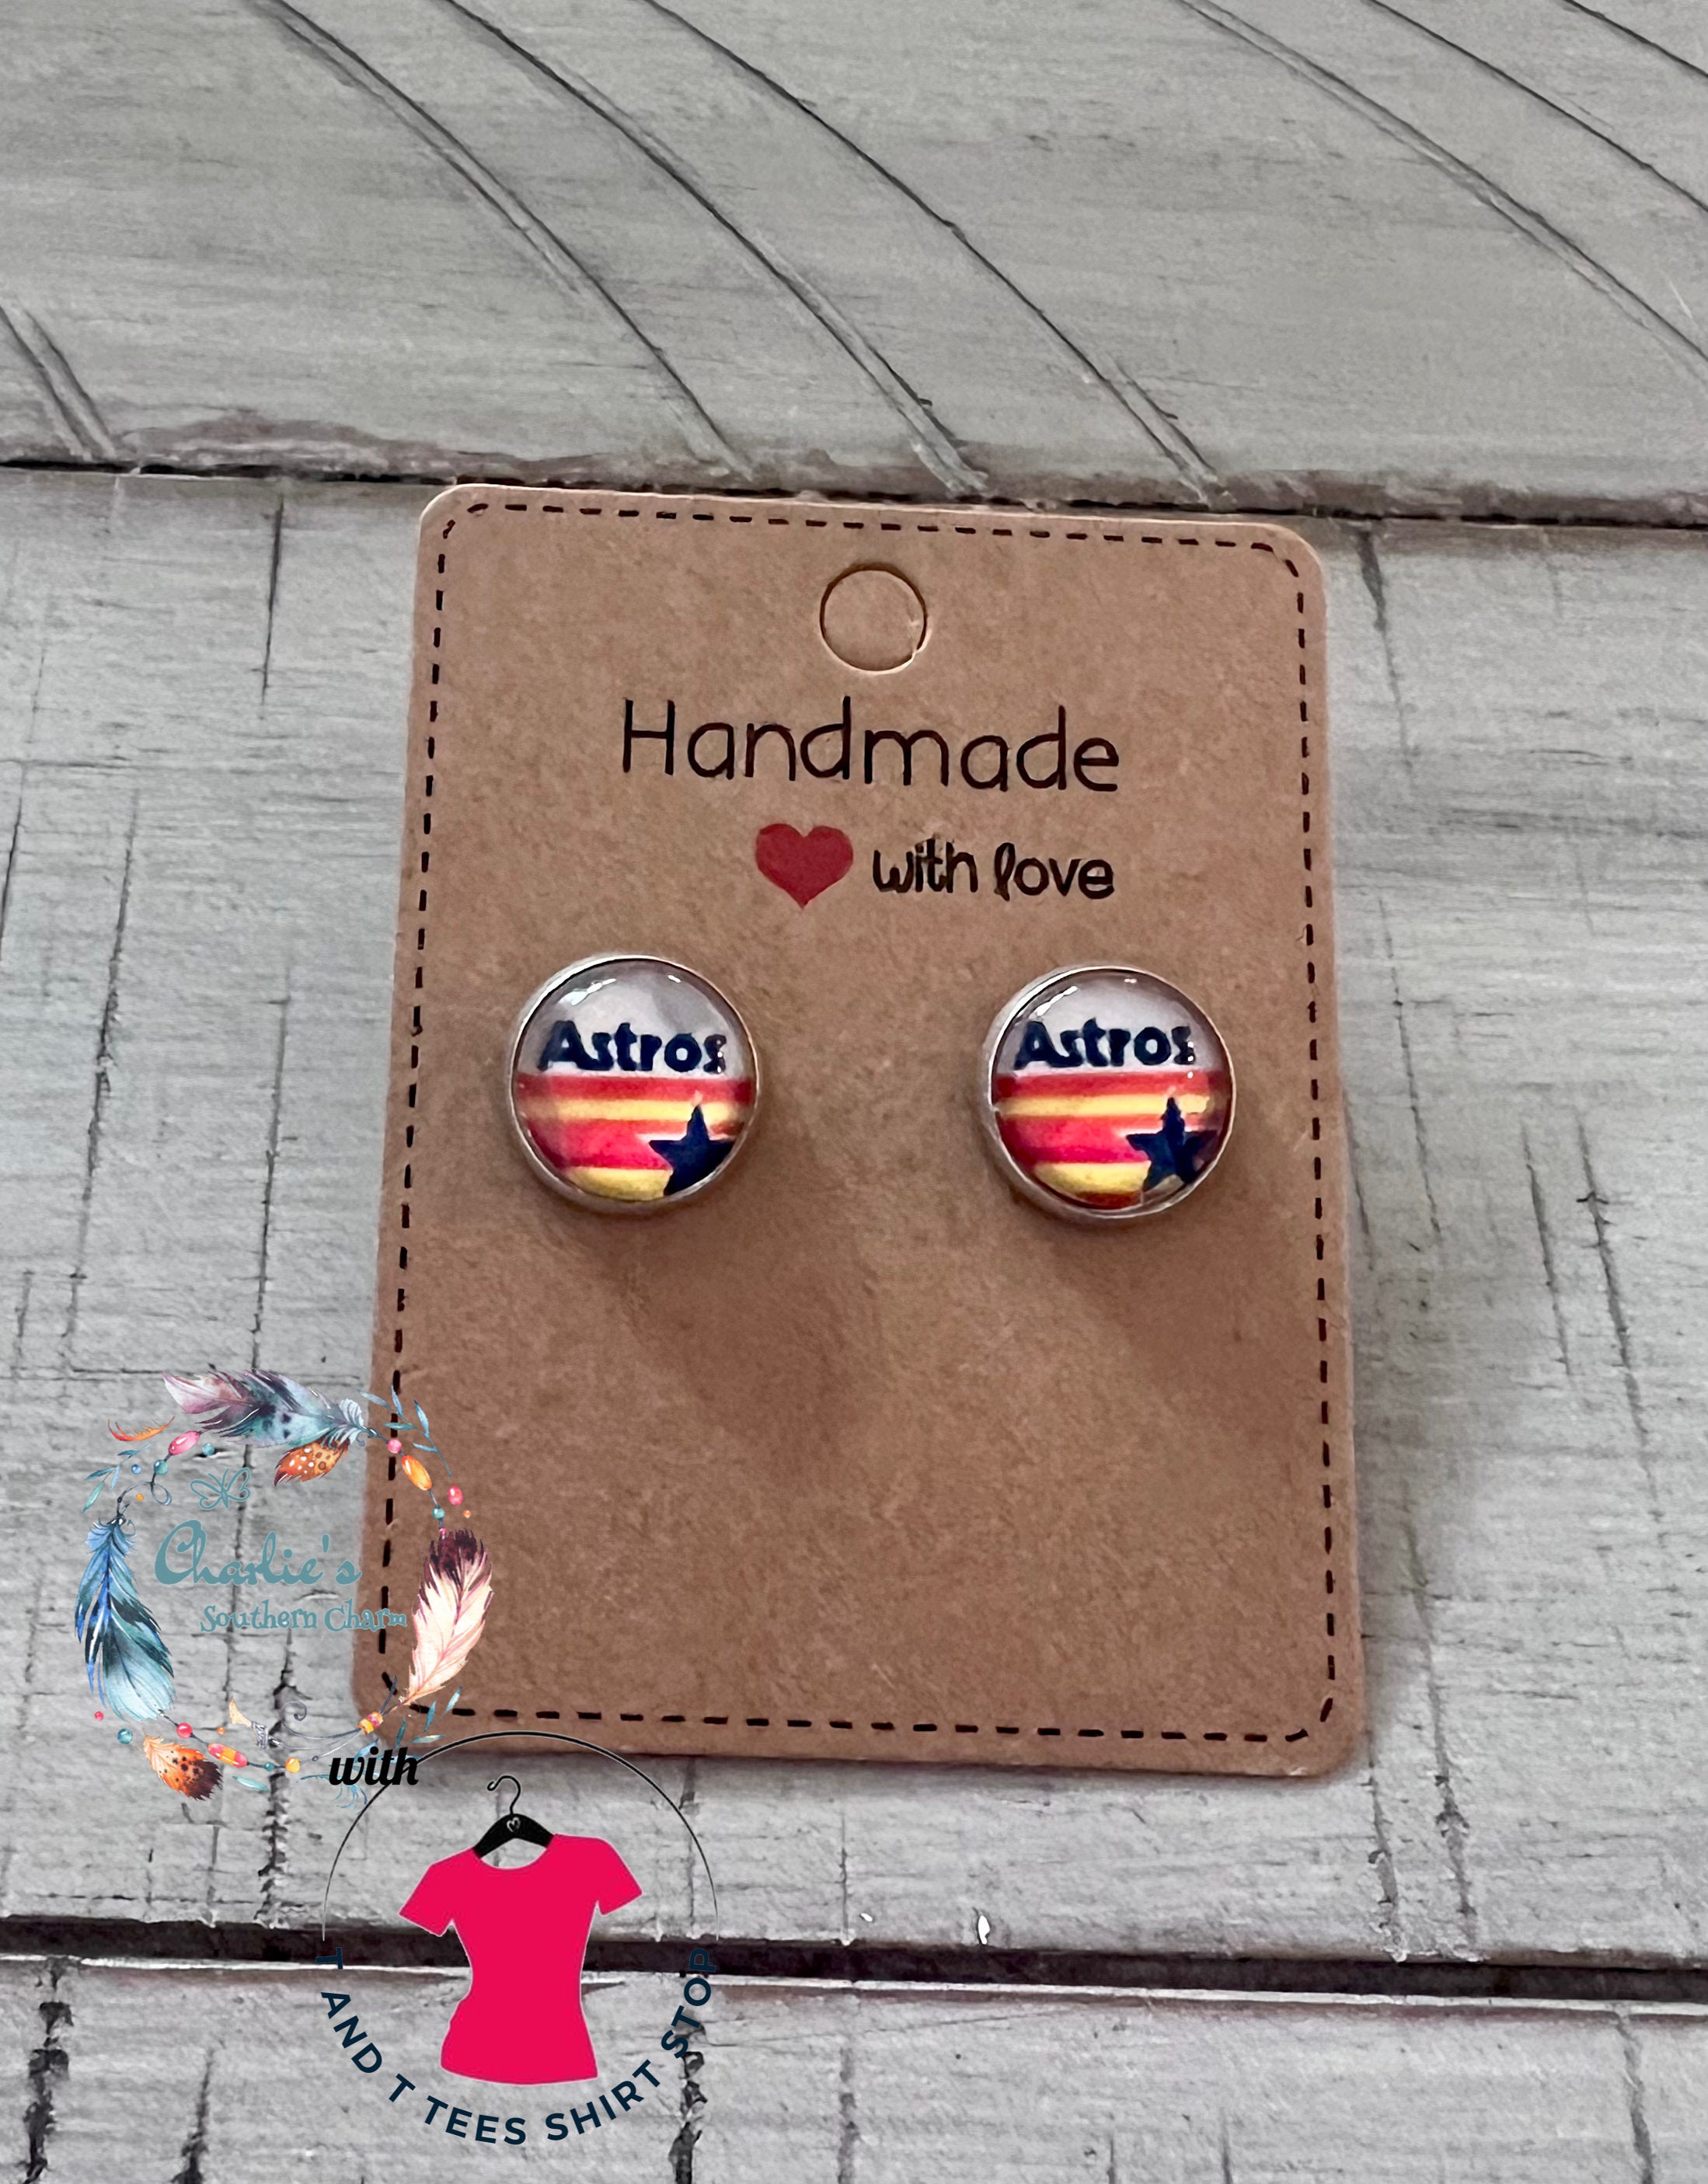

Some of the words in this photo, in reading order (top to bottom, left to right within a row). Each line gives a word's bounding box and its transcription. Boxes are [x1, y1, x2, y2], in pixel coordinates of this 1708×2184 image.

[622, 695, 1119, 792] Handmade
[872, 835, 978, 893] with
[994, 841, 1115, 901] love
[538, 1019, 728, 1074] Astros
[1013, 1018, 1197, 1071] Astros
